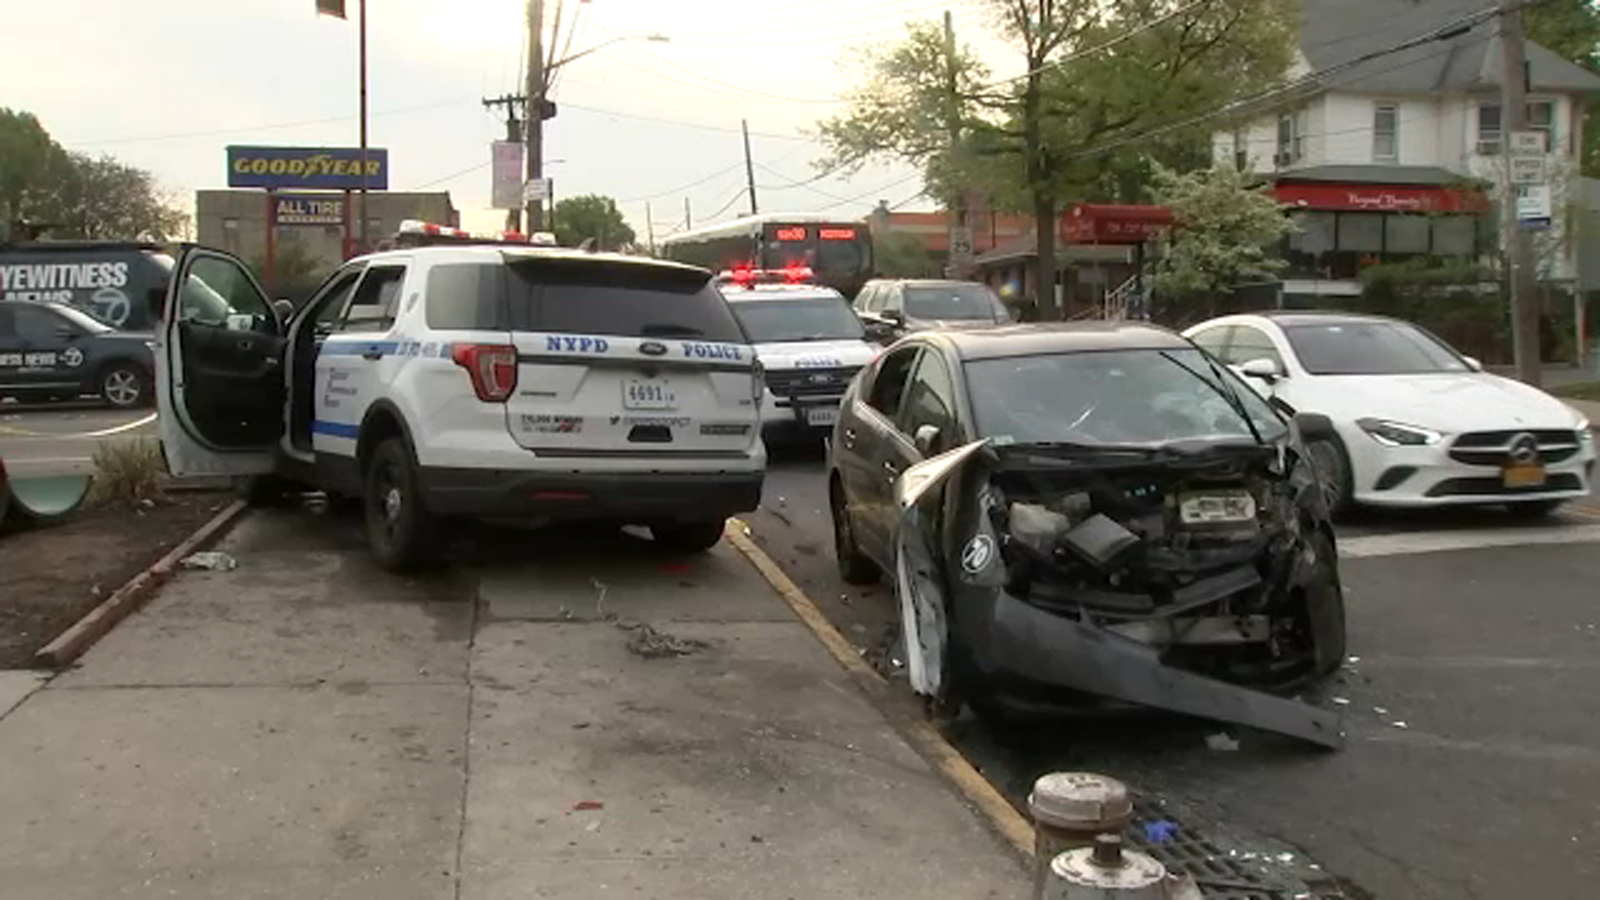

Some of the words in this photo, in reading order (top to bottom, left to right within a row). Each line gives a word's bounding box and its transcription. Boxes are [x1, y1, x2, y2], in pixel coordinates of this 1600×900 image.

[233, 156, 381, 179] GOODYEAR
[277, 200, 305, 214] ALL
[306, 200, 343, 214] TIRE
[953, 241, 971, 253] 25
[547, 335, 609, 353] NYPD
[682, 343, 743, 360] POLICE
[795, 359, 843, 369] POLICE
[629, 385, 662, 401] 4691
